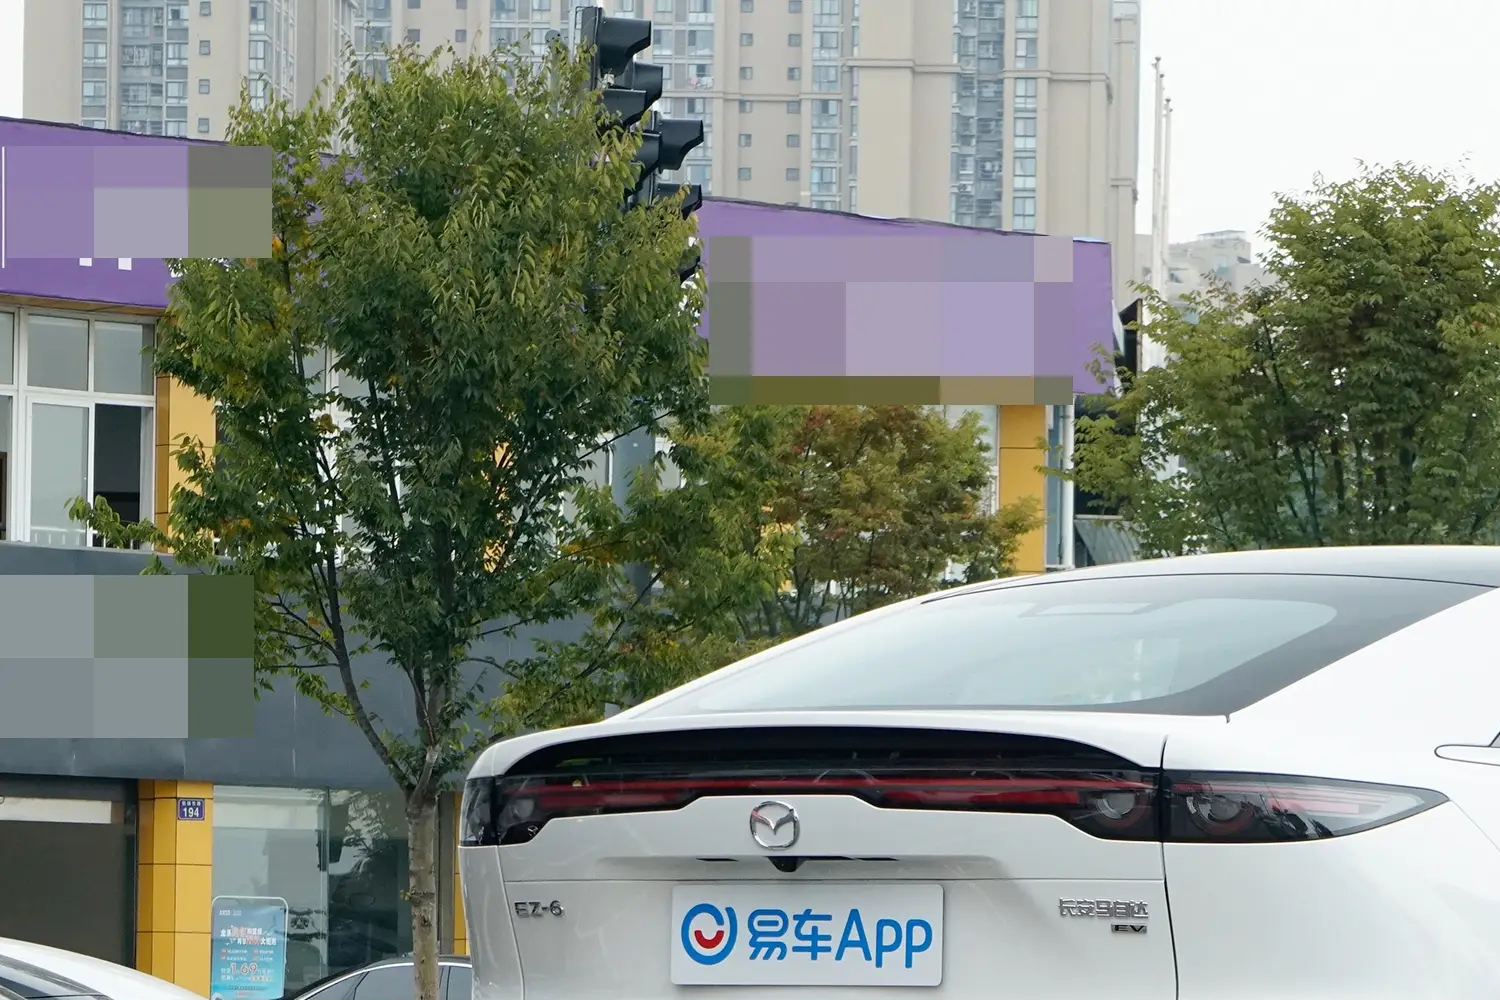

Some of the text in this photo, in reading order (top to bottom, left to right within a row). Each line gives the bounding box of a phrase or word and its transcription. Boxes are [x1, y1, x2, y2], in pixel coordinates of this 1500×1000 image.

[183, 807, 199, 818] 194
[514, 900, 565, 918] EZ-6
[1058, 896, 1149, 919] 长安马自达
[1113, 923, 1147, 933] EV
